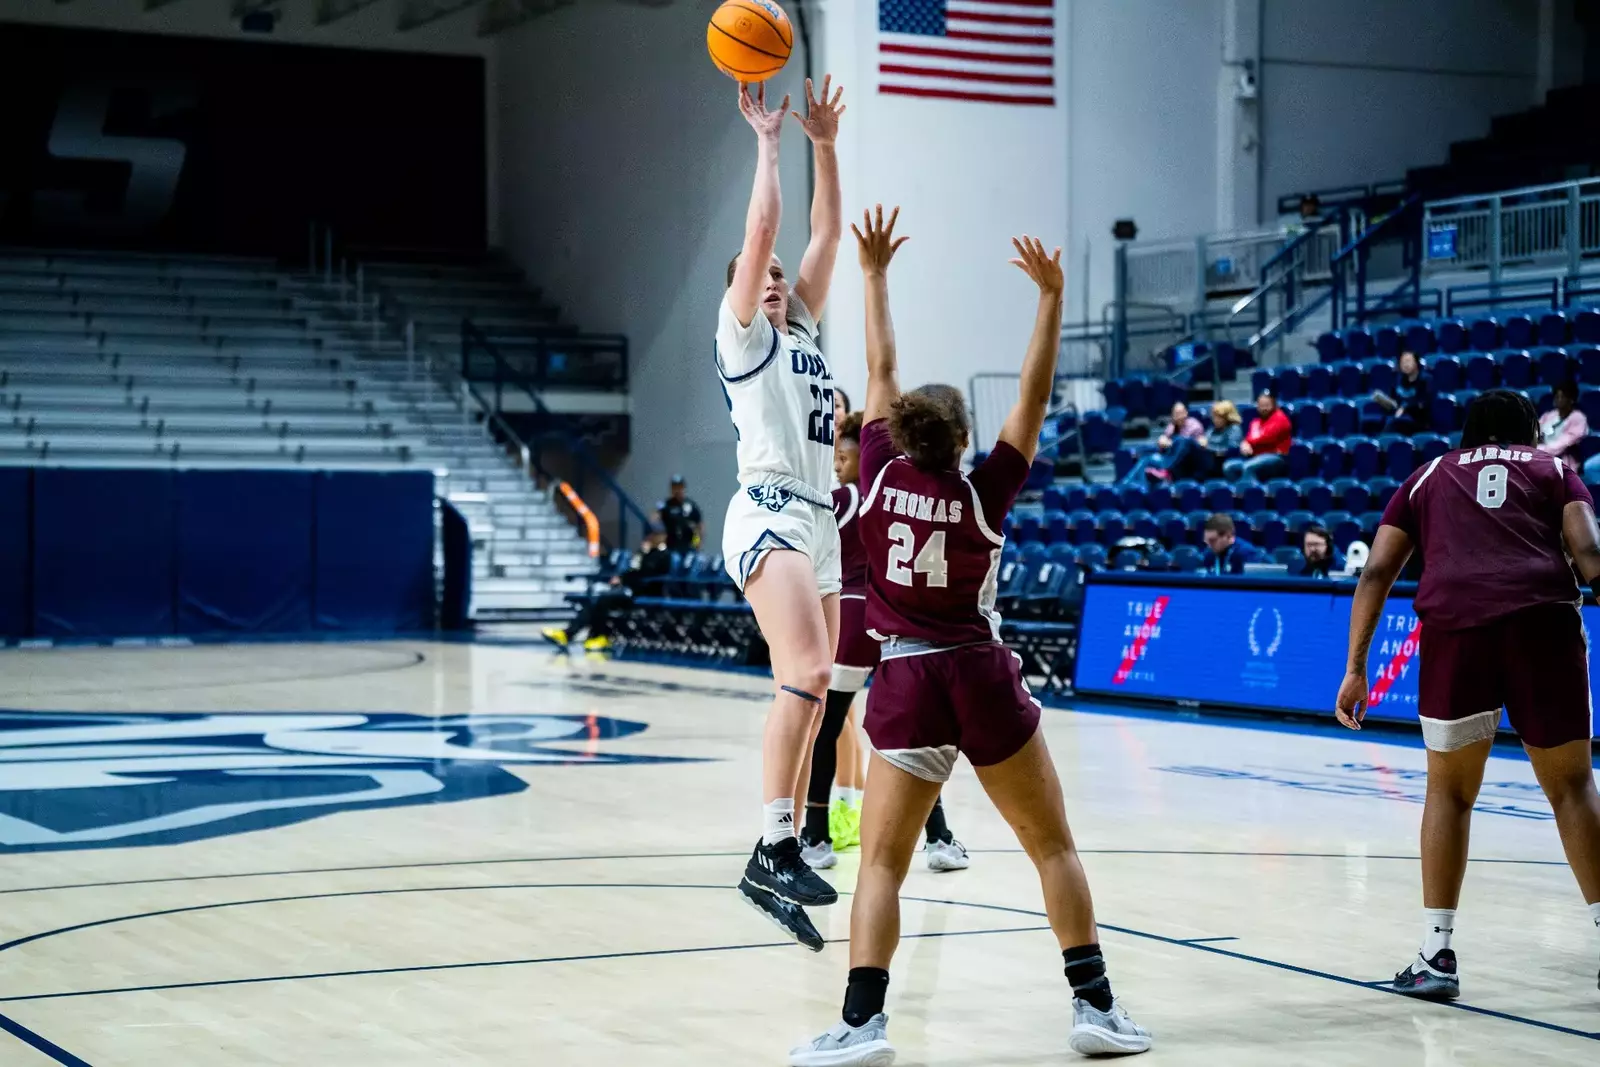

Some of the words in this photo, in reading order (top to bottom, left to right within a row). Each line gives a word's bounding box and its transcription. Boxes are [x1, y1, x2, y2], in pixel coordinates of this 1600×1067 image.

[790, 350, 833, 380] OWL
[807, 384, 834, 446] 22
[1476, 465, 1509, 509] 8
[882, 486, 963, 524] THOMAS
[885, 521, 948, 588] 24
[1127, 600, 1162, 619] TRUE
[1123, 624, 1162, 640] ANOM
[1386, 615, 1419, 632] TRU
[1121, 644, 1148, 661] ALY
[1375, 663, 1410, 680] ALY
